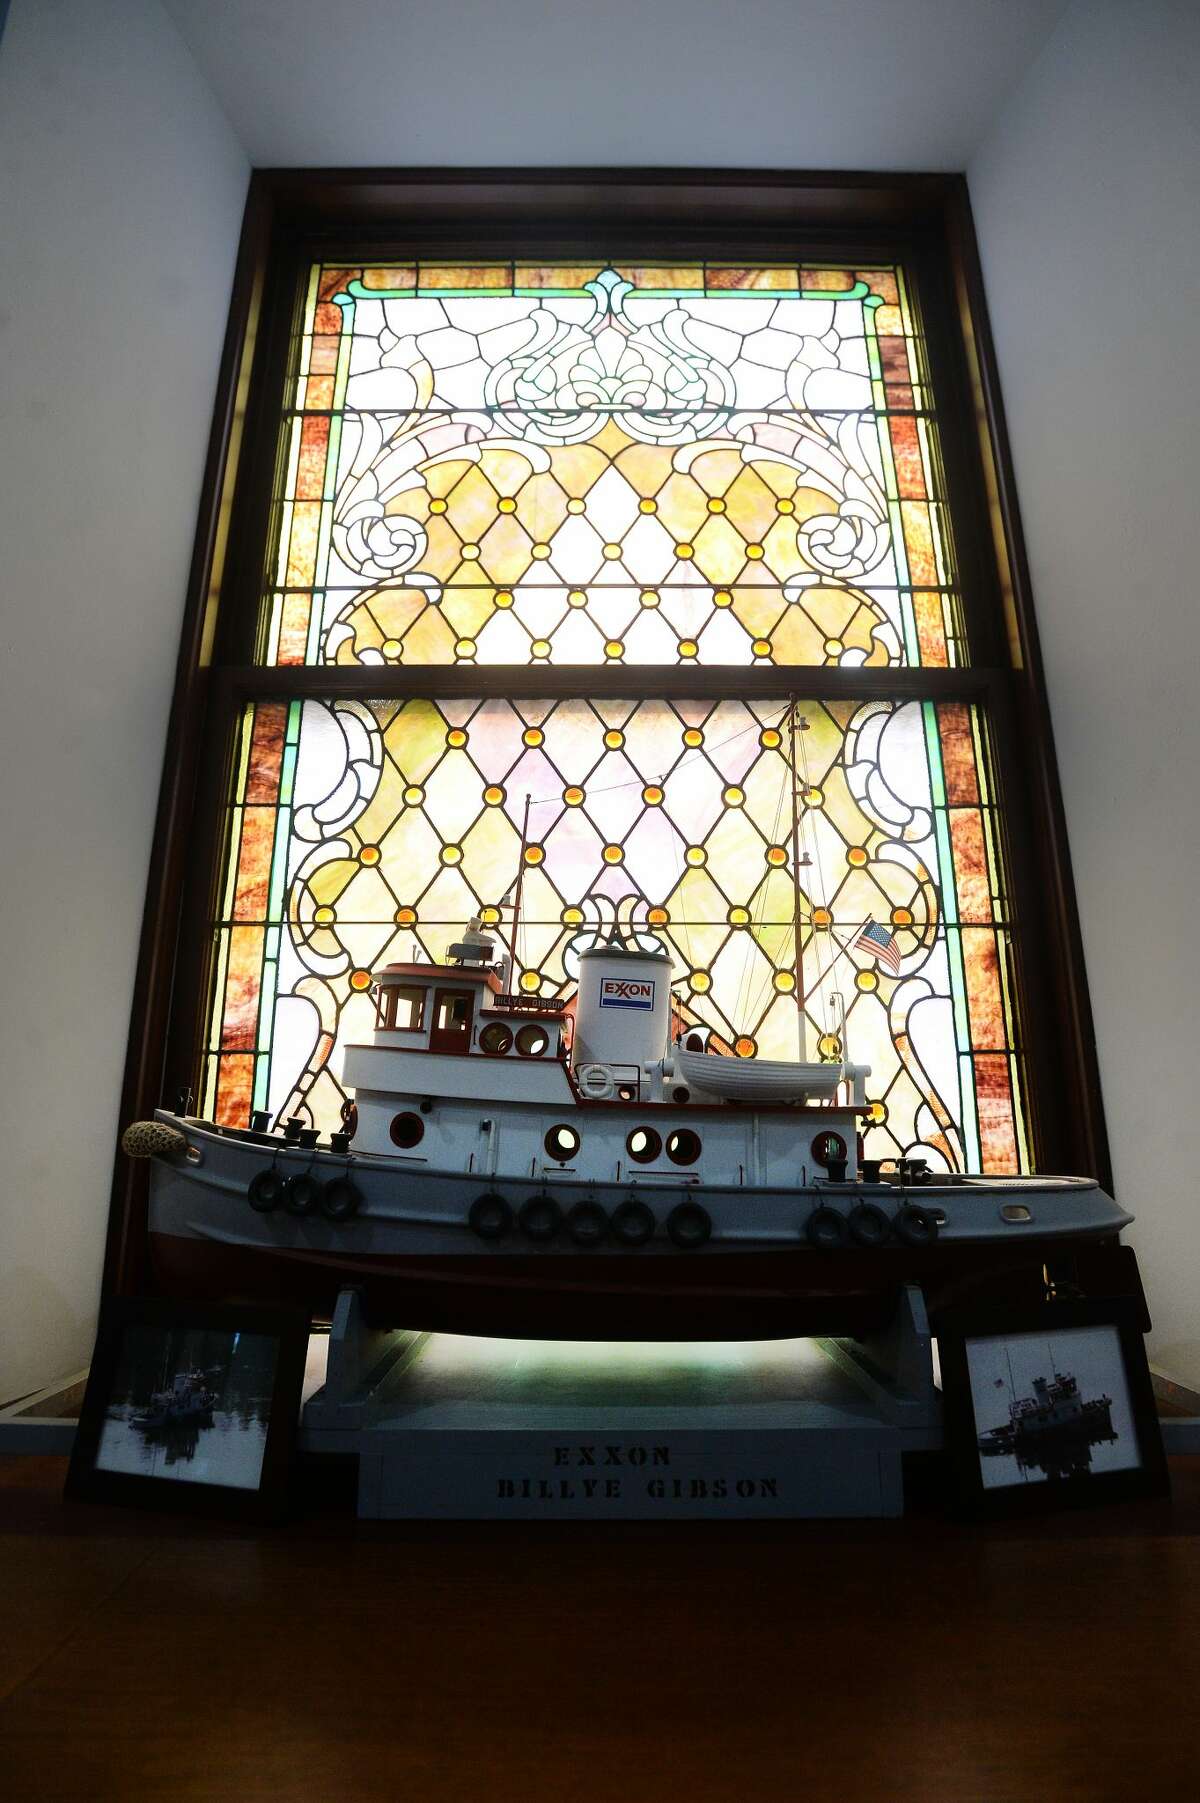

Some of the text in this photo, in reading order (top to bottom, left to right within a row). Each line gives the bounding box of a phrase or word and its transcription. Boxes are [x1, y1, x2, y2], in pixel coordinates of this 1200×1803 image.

[604, 982, 651, 999] EXXON
[531, 1000, 564, 1009] GIBSON
[554, 1447, 669, 1466] EXXON
[497, 1479, 778, 1498] BILLYE GIBSON
